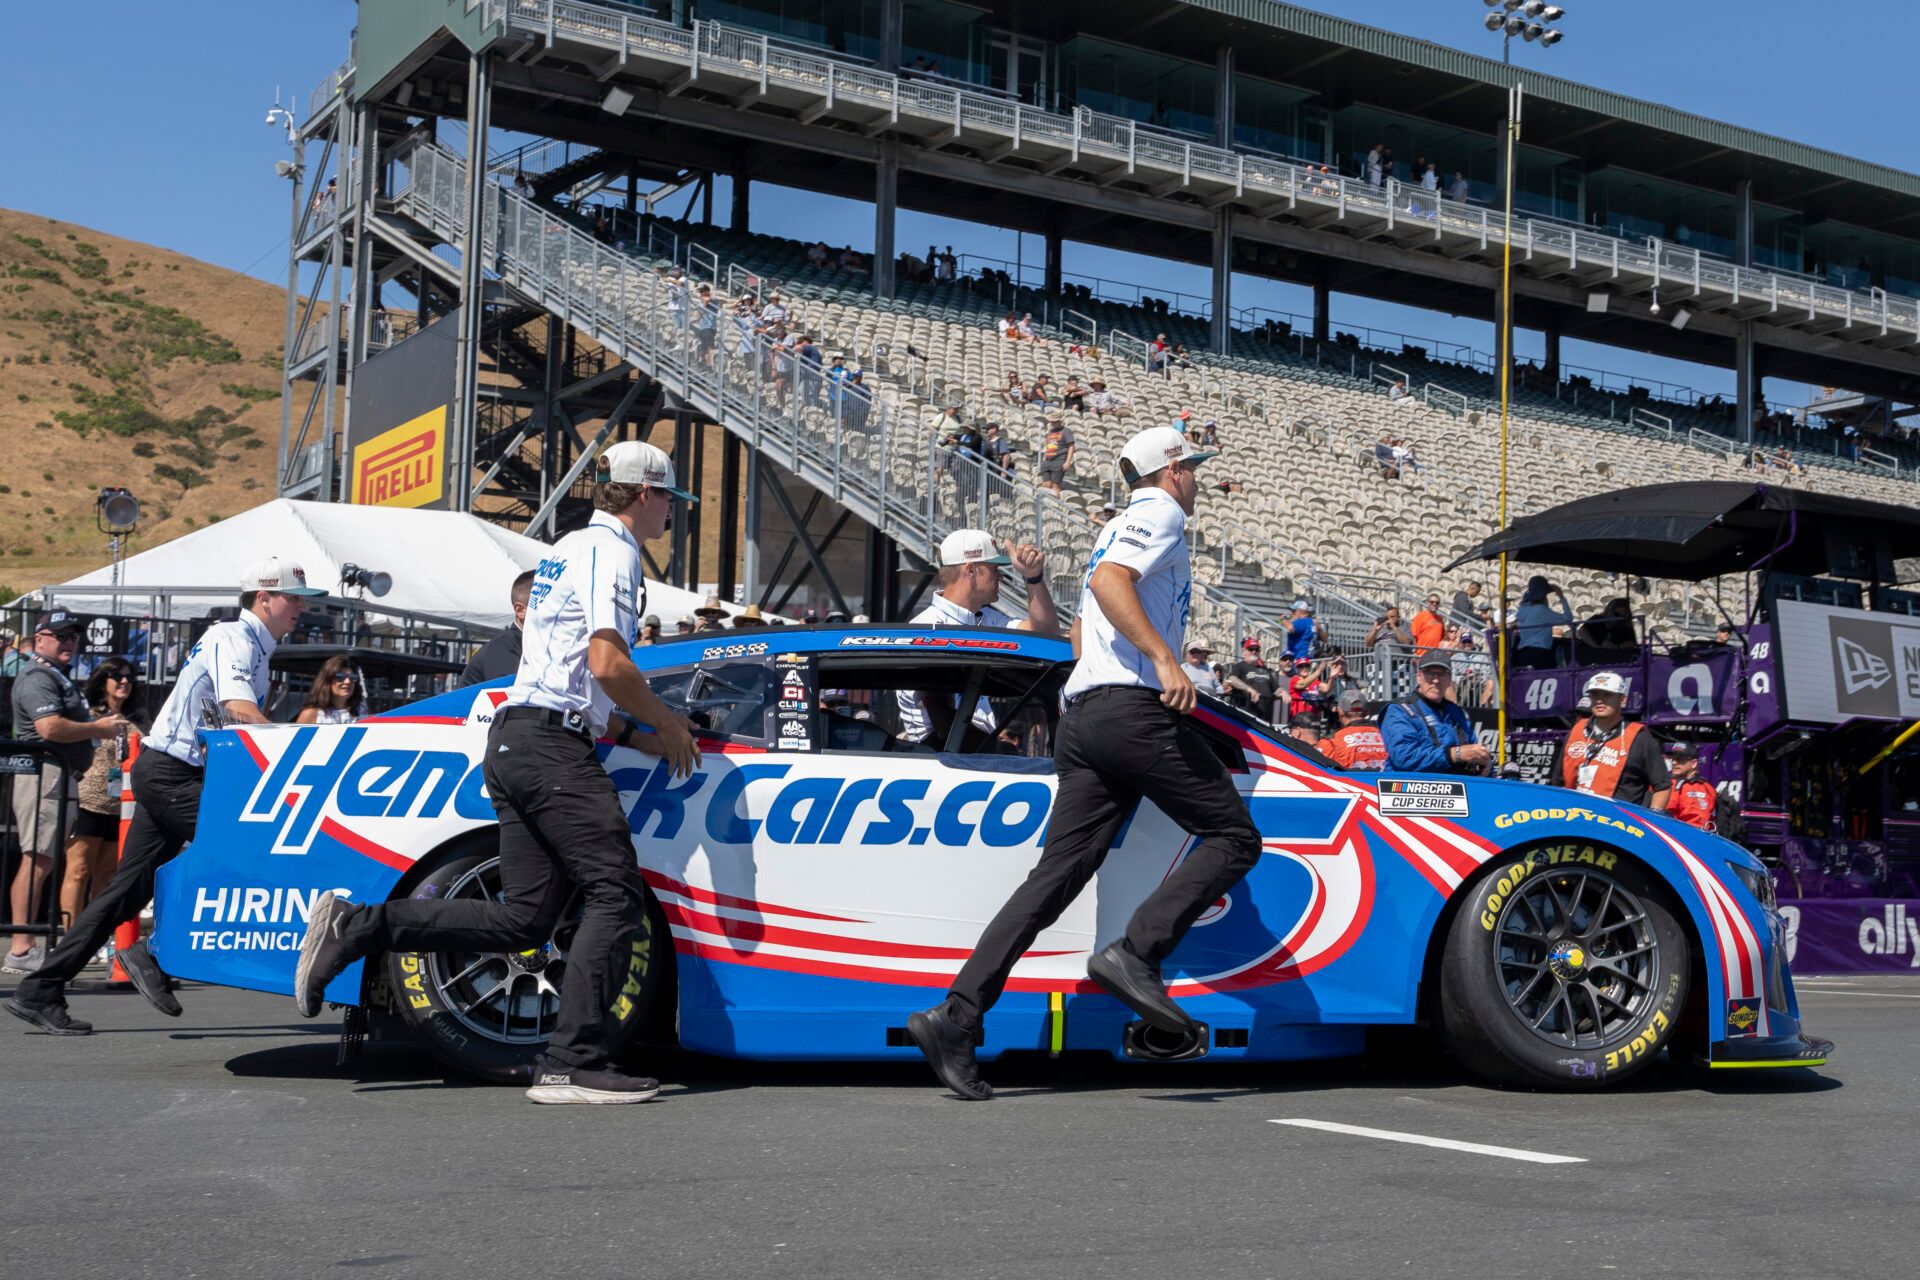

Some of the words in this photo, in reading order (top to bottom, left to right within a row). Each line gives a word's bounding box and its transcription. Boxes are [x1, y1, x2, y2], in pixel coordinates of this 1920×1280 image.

[359, 429, 436, 505] PIRELLI
[1751, 642, 1770, 659] 48
[1524, 678, 1558, 710] 48
[1406, 782, 1453, 795] NASCAR
[1392, 797, 1415, 807] CUP
[1416, 798, 1456, 809] SERIES
[1494, 807, 1646, 839] GOODYEAR
[191, 886, 353, 923] HIRIN
[1729, 1010, 1759, 1025] SUNOCO
[1605, 1008, 1670, 1071] EAGLE
[540, 1074, 570, 1085] HOKA
